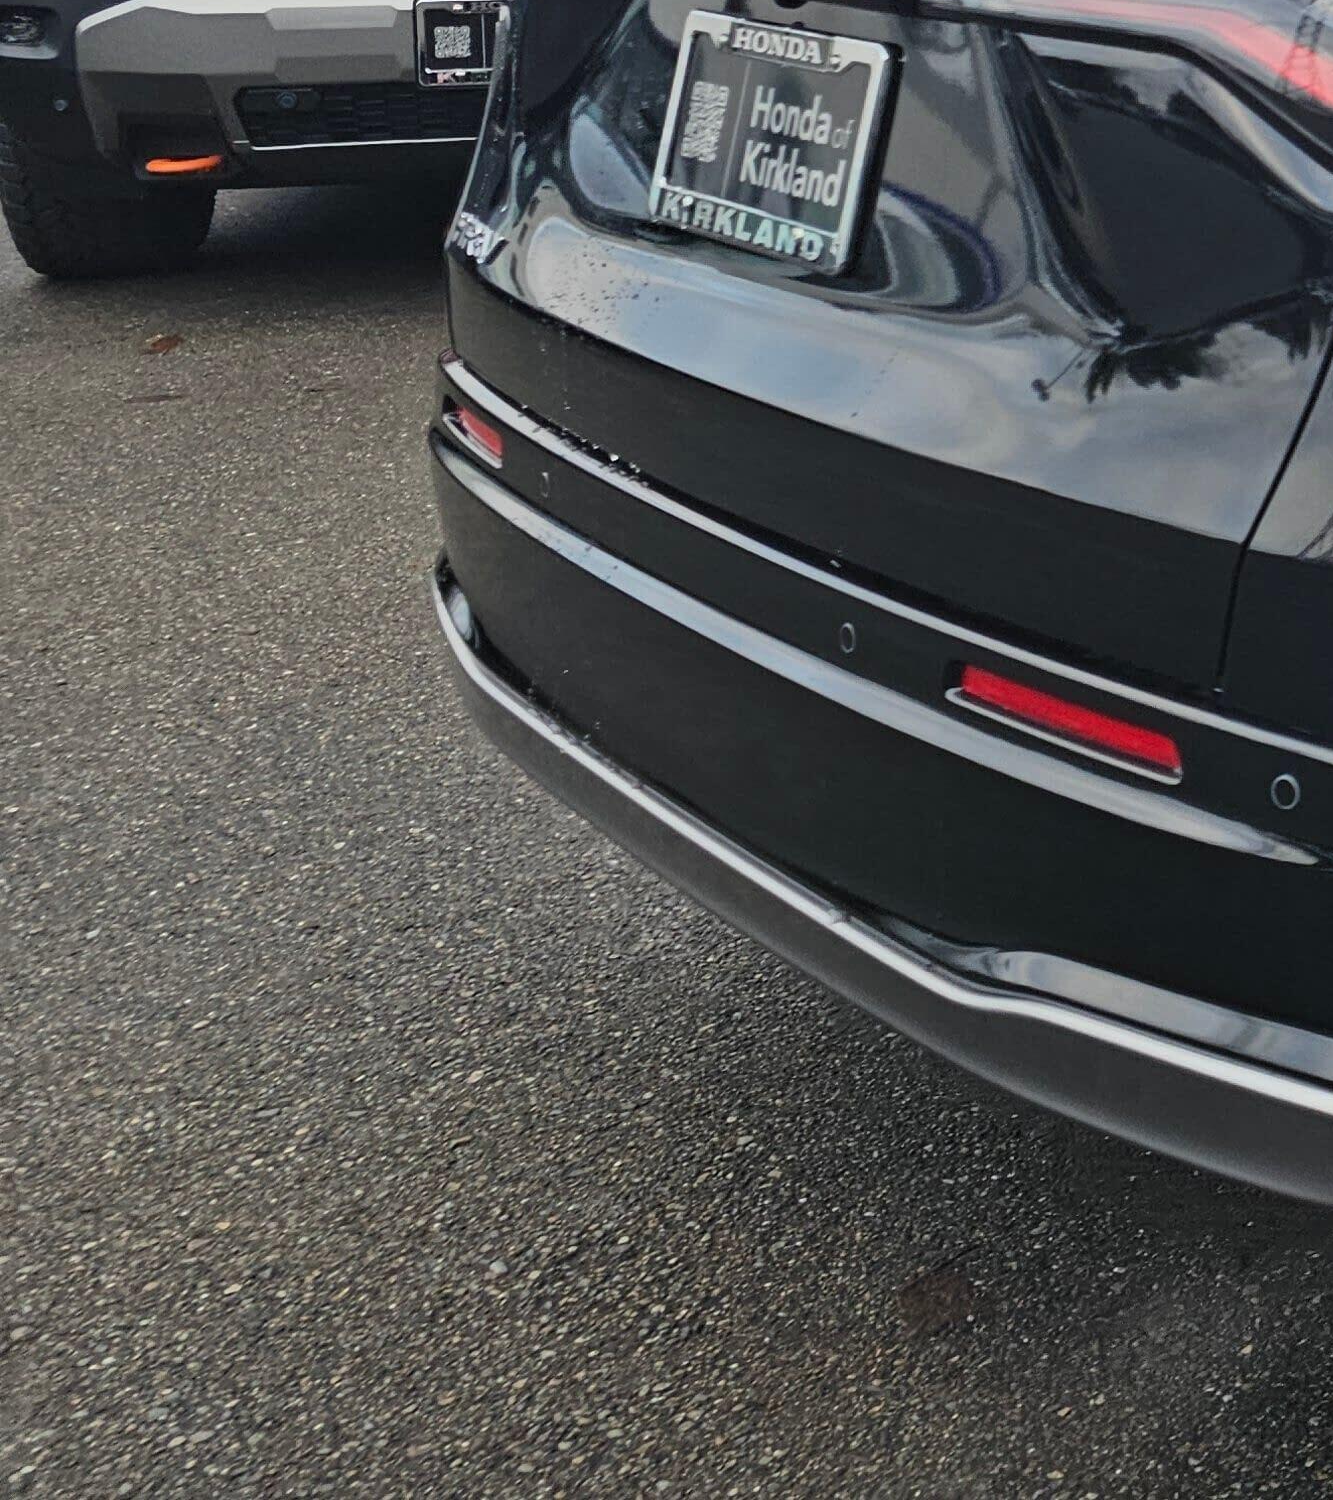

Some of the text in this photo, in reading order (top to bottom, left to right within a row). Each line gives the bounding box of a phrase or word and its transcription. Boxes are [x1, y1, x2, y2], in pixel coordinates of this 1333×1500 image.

[731, 26, 824, 65] HONDA
[749, 84, 854, 150] Honda of
[739, 139, 847, 208] Kirkland
[660, 191, 825, 262] KIRKLAND
